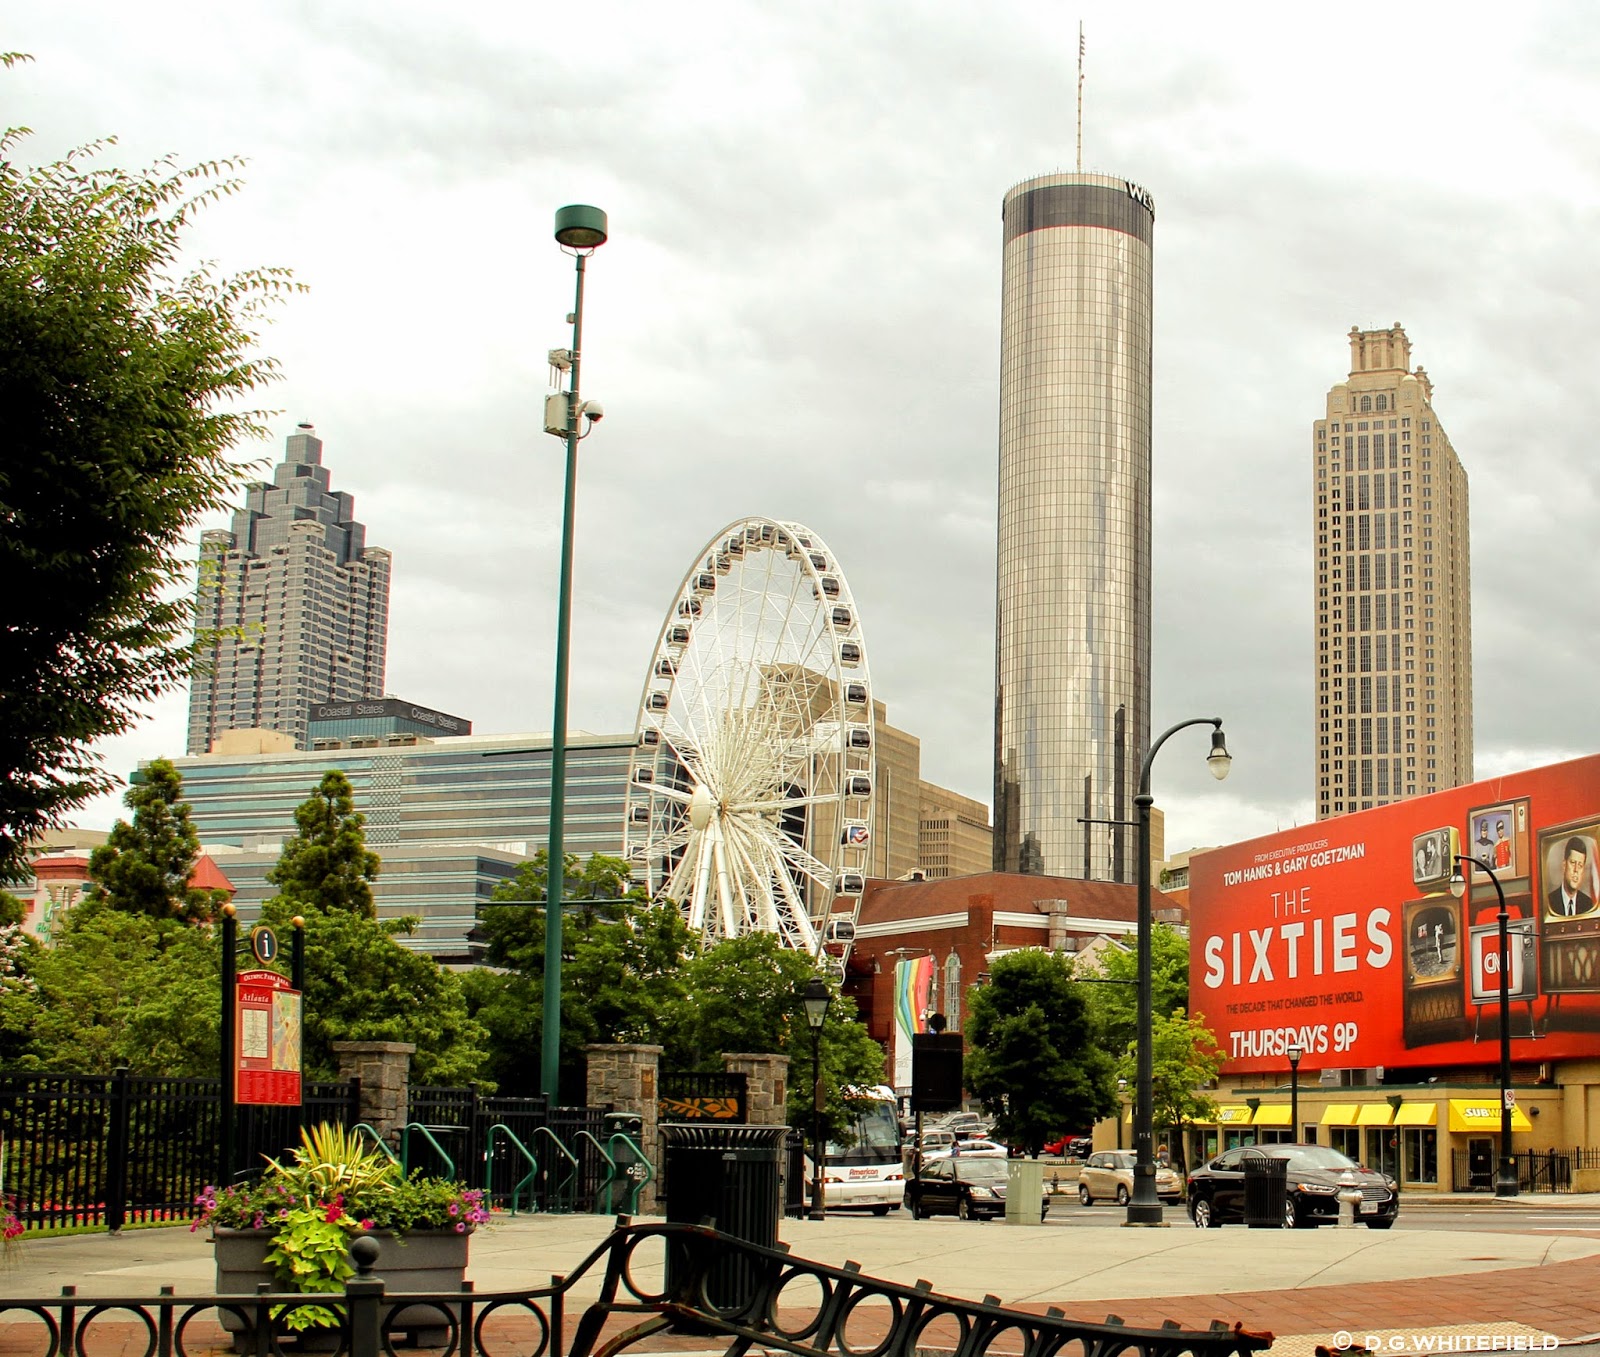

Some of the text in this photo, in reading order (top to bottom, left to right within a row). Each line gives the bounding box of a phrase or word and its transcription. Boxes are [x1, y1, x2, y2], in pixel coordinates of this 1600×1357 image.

[319, 703, 384, 717] Coastal States
[411, 707, 458, 730] Coastal States
[1254, 839, 1329, 863] FROM EXECUTIVE PRODUCERS
[1224, 842, 1365, 886] TOM HANKS & GARY GOETZMAN
[1270, 886, 1311, 918] THE
[1203, 907, 1393, 989] SIXTIES
[1484, 951, 1510, 974] CN
[241, 993, 269, 1003] Atlanta
[1226, 1004, 1239, 1015] THE
[1240, 1001, 1266, 1014] DECADE
[1267, 999, 1284, 1010] THAT
[1284, 995, 1319, 1009] CHANGED
[1319, 993, 1333, 1006] THE
[1229, 1021, 1358, 1058] THURSDAYS 9P
[849, 1168, 879, 1176] American
